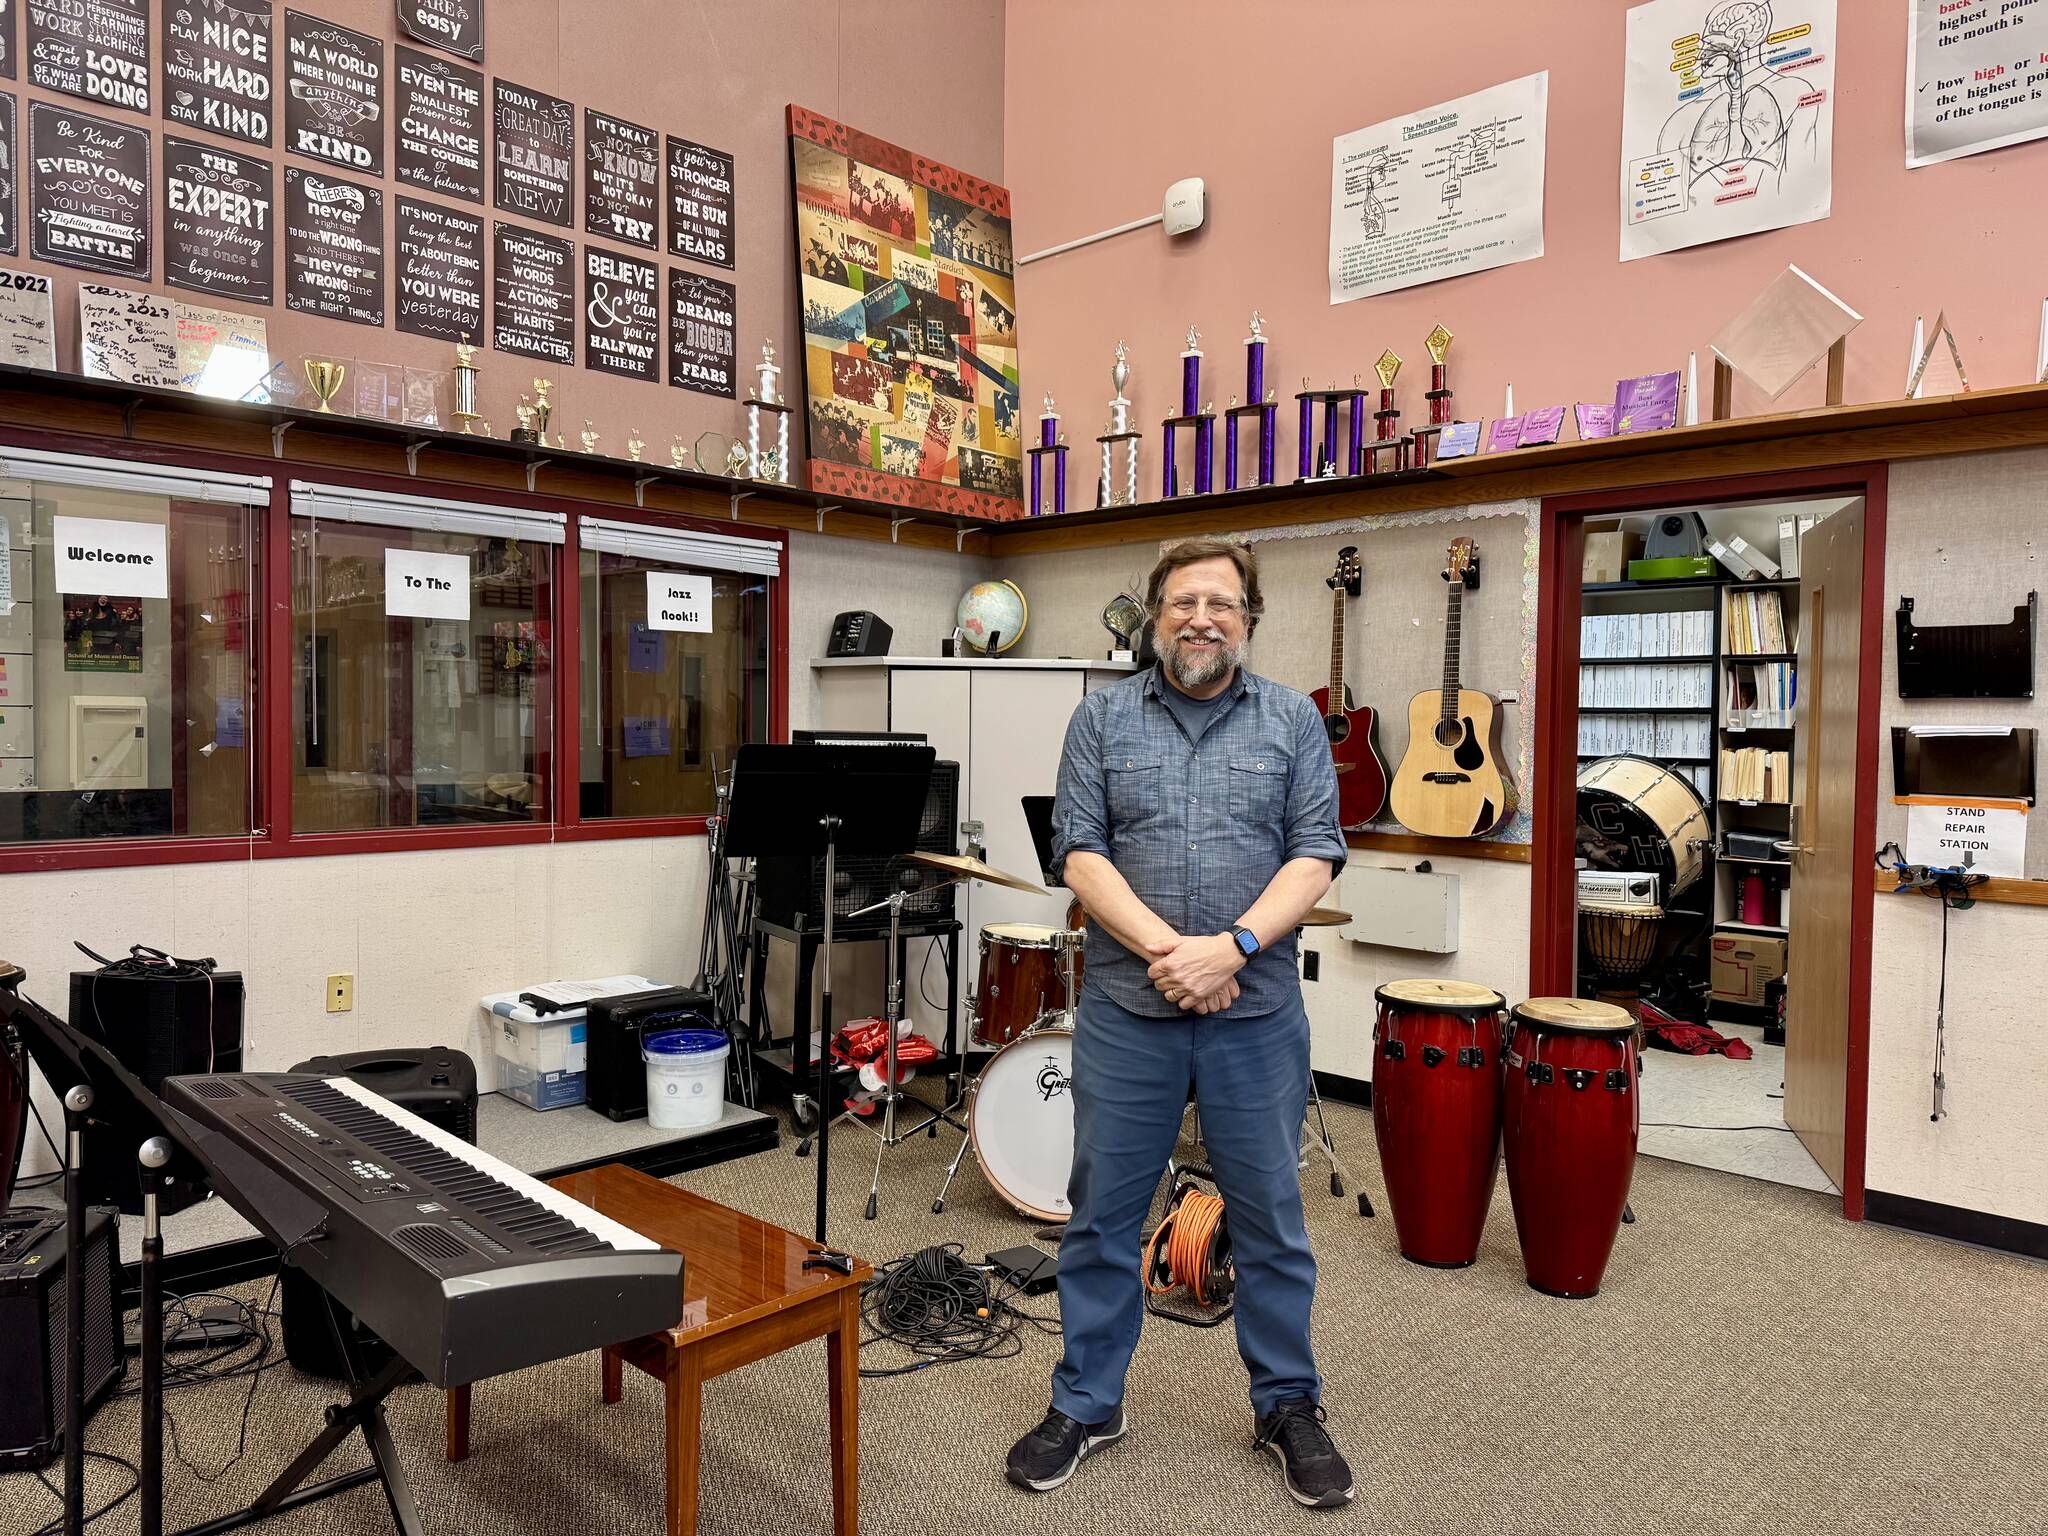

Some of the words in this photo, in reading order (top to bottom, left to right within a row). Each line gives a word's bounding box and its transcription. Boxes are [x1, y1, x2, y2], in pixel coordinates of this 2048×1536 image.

[30, 7, 84, 37] WORK
[87, 3, 145, 28] PERSEVERANCE
[87, 11, 145, 36] LEARNING
[416, 8, 462, 41] easy
[1939, 8, 1987, 31] highest
[2000, 0, 2038, 15] poin
[89, 21, 144, 50] STUDYING
[170, 24, 199, 43] PLAY
[203, 16, 267, 64] NICE
[1938, 35, 1959, 47] the
[1964, 18, 2008, 40] mouth
[2012, 14, 2024, 26] is
[87, 34, 146, 58] SACRIFICE
[290, 37, 305, 57] IN
[308, 44, 321, 62] A
[323, 47, 379, 80] WORLD
[86, 49, 148, 85] LOVE
[166, 62, 202, 84] WORK
[203, 57, 269, 101] HARD
[293, 60, 324, 81] WHERE
[326, 70, 344, 87] YOU
[345, 75, 363, 94] CAN
[365, 83, 376, 98] BE
[1937, 77, 1965, 91] how
[1974, 65, 2005, 81] high
[2014, 59, 2031, 71] or
[35, 72, 57, 86] YOU
[60, 78, 82, 92] ARE
[86, 73, 148, 109] DOING
[400, 66, 446, 96] EVEN
[447, 79, 479, 106] THE
[1936, 95, 1958, 107] the
[1967, 78, 2017, 99] highest
[306, 85, 364, 113] anything
[410, 91, 470, 119] SMALLEST
[496, 87, 539, 111] TODAY
[1936, 110, 1950, 123] of
[1953, 105, 1975, 119] the
[1978, 94, 2026, 113] tongue
[2031, 89, 2042, 100] is
[170, 104, 199, 123] STAY
[203, 97, 268, 141] KIND
[327, 123, 344, 138] BE
[502, 106, 541, 136] GREAT
[542, 121, 566, 147] DAY
[596, 118, 617, 136] IT'S
[619, 126, 650, 147] OKAY
[1407, 130, 1427, 140] Speech
[1428, 120, 1458, 134] production
[1415, 118, 1438, 131] Human
[57, 120, 78, 139] Be
[83, 127, 125, 151] Kind
[297, 128, 373, 168] KIND
[401, 117, 480, 155] CHANGE
[605, 135, 633, 156] NOT
[201, 153, 238, 176] THE
[401, 137, 428, 155] THE
[431, 146, 480, 171] COURSE
[498, 139, 570, 182] LEARN
[602, 149, 657, 186] KNOW
[36, 157, 145, 197] EVERYONE
[412, 166, 433, 183] the
[433, 173, 468, 194] future
[503, 167, 564, 194] SOMETHING
[670, 163, 731, 195] STRONGER
[50, 194, 78, 211] YOU
[82, 202, 118, 222] MEET
[121, 210, 134, 223] IS
[168, 177, 269, 231] EXPERT
[503, 181, 564, 218] NEW
[602, 184, 623, 201] NOT
[625, 190, 653, 210] OKAY
[675, 196, 700, 220] THE
[702, 203, 728, 226] SUM
[805, 198, 849, 225] GOODMAN
[307, 202, 362, 225] never
[401, 204, 421, 220] IT'S
[422, 211, 444, 225] NOT
[445, 217, 480, 235] ABOUT
[611, 212, 654, 242] TRY
[51, 229, 133, 260] BATTLE
[173, 217, 191, 231] in
[195, 220, 264, 255] anything
[676, 231, 727, 262] FEARS
[401, 241, 419, 257] IT'S
[419, 246, 452, 264] ABOUT
[453, 253, 480, 272] BEING
[502, 238, 564, 266] THOUGHTS
[187, 258, 251, 286] beginner
[308, 256, 362, 279] never
[407, 258, 443, 282] better
[446, 269, 475, 288] than
[512, 264, 555, 286] WORDS
[588, 253, 655, 291] BELIEVE
[934, 257, 965, 277] Stardust
[0, 271, 48, 293] 2022
[401, 276, 436, 299] YOU
[436, 285, 480, 310] WERE
[864, 281, 899, 308] Caravan
[127, 303, 169, 319] 2023
[300, 297, 317, 309] THE
[320, 300, 344, 315] RIGHT
[347, 306, 371, 320] THING
[508, 287, 559, 310] ACTIONS
[633, 303, 657, 319] can
[676, 299, 733, 327] DREAMS
[401, 297, 480, 331] yesterday
[513, 311, 555, 332] HABITS
[498, 332, 569, 360] CHARACTER
[590, 334, 654, 361] HALFWAY
[623, 326, 657, 343] you're
[672, 316, 686, 330] BE
[685, 320, 733, 357] BIGGER
[600, 353, 646, 374] THERE
[682, 361, 728, 386] FEARS
[67, 546, 154, 565] Welcome
[404, 575, 423, 590] To
[425, 577, 452, 591] The
[667, 587, 693, 600] Jazz
[660, 609, 699, 623] Nook!!
[1590, 801, 1625, 834] C
[1946, 806, 1986, 818] STAND
[1944, 823, 1985, 834] REPAIR
[1631, 834, 1665, 867] H
[1939, 838, 1989, 850] STATION
